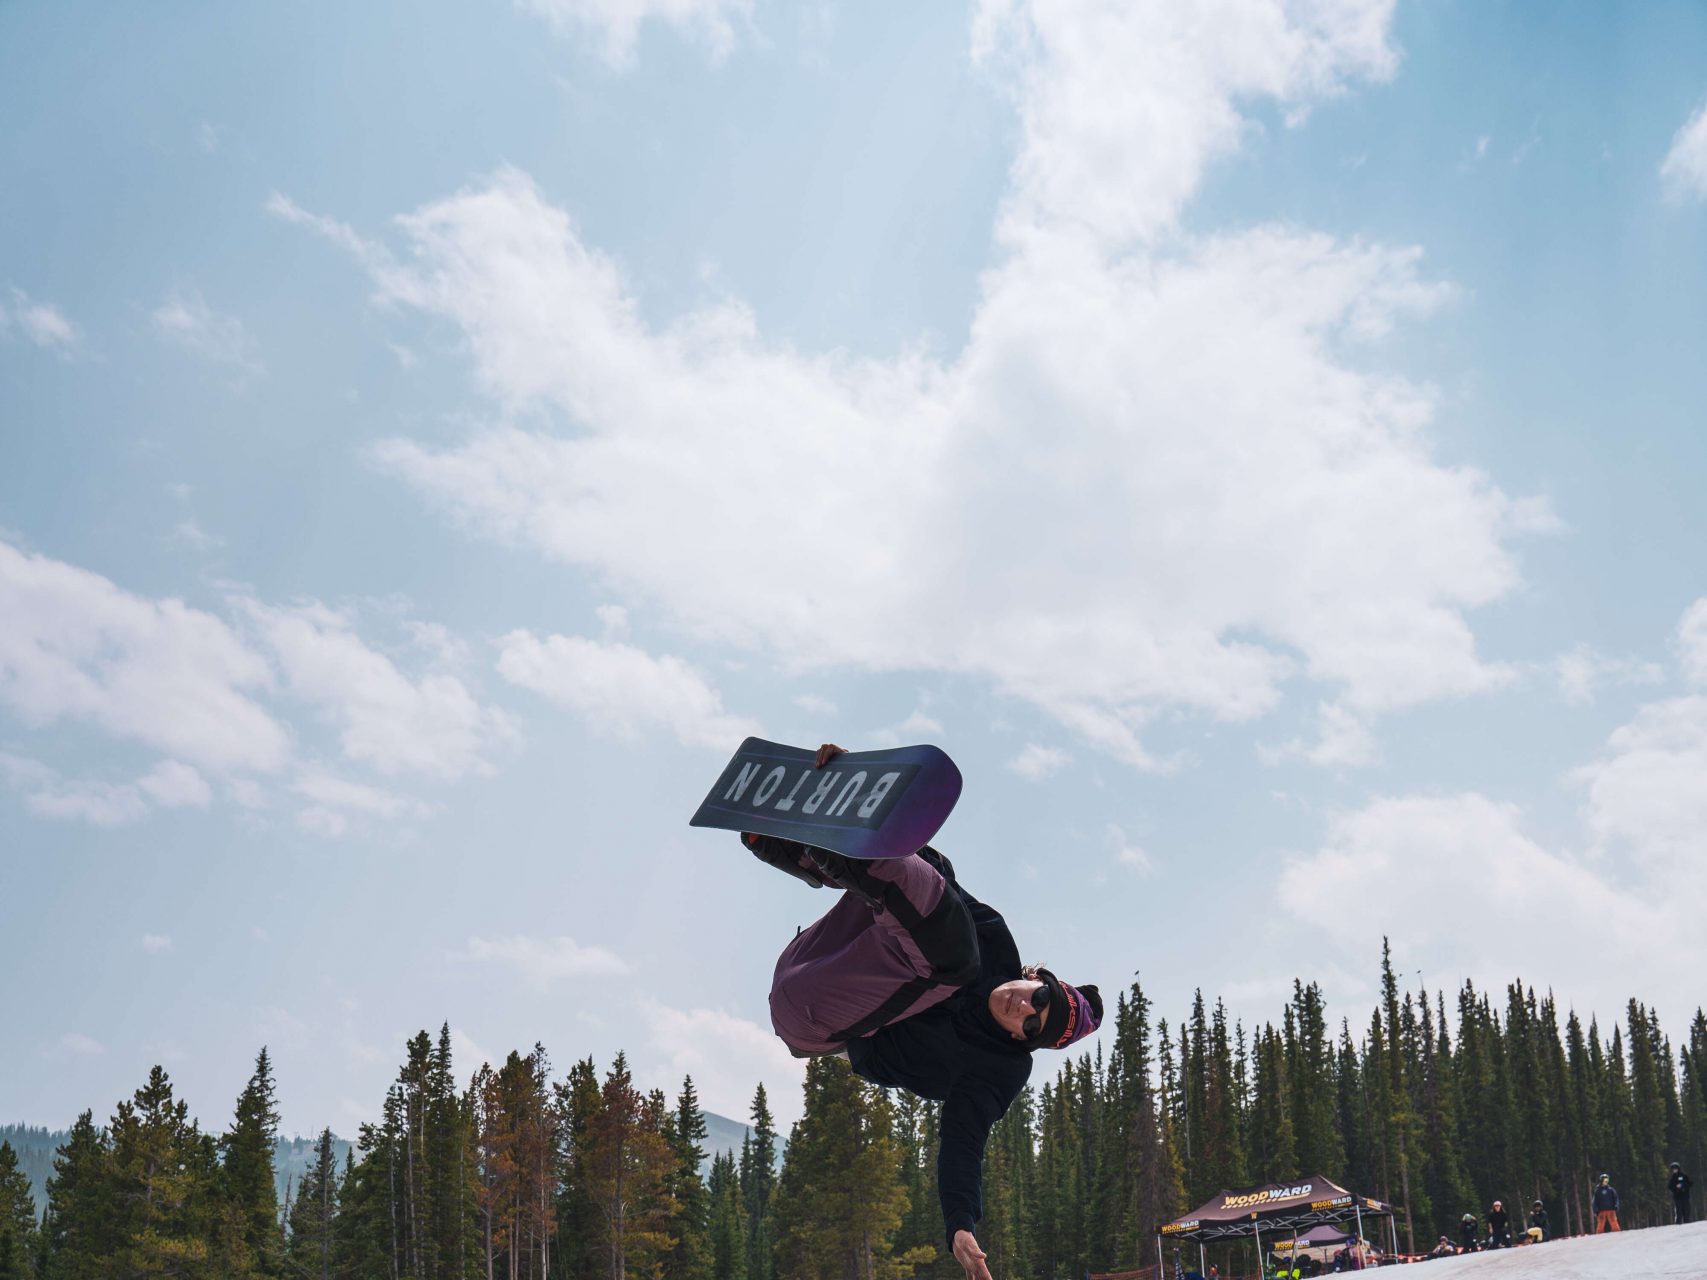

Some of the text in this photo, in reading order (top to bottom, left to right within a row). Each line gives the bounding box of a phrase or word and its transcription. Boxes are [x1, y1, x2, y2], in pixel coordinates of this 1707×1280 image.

[723, 761, 901, 819] BURTON
[1225, 1184, 1312, 1206] WOODWARD
[1311, 1196, 1352, 1209] WOODWARD
[1161, 1220, 1200, 1233] WOODWARD
[1274, 1239, 1311, 1250] WOODARD
